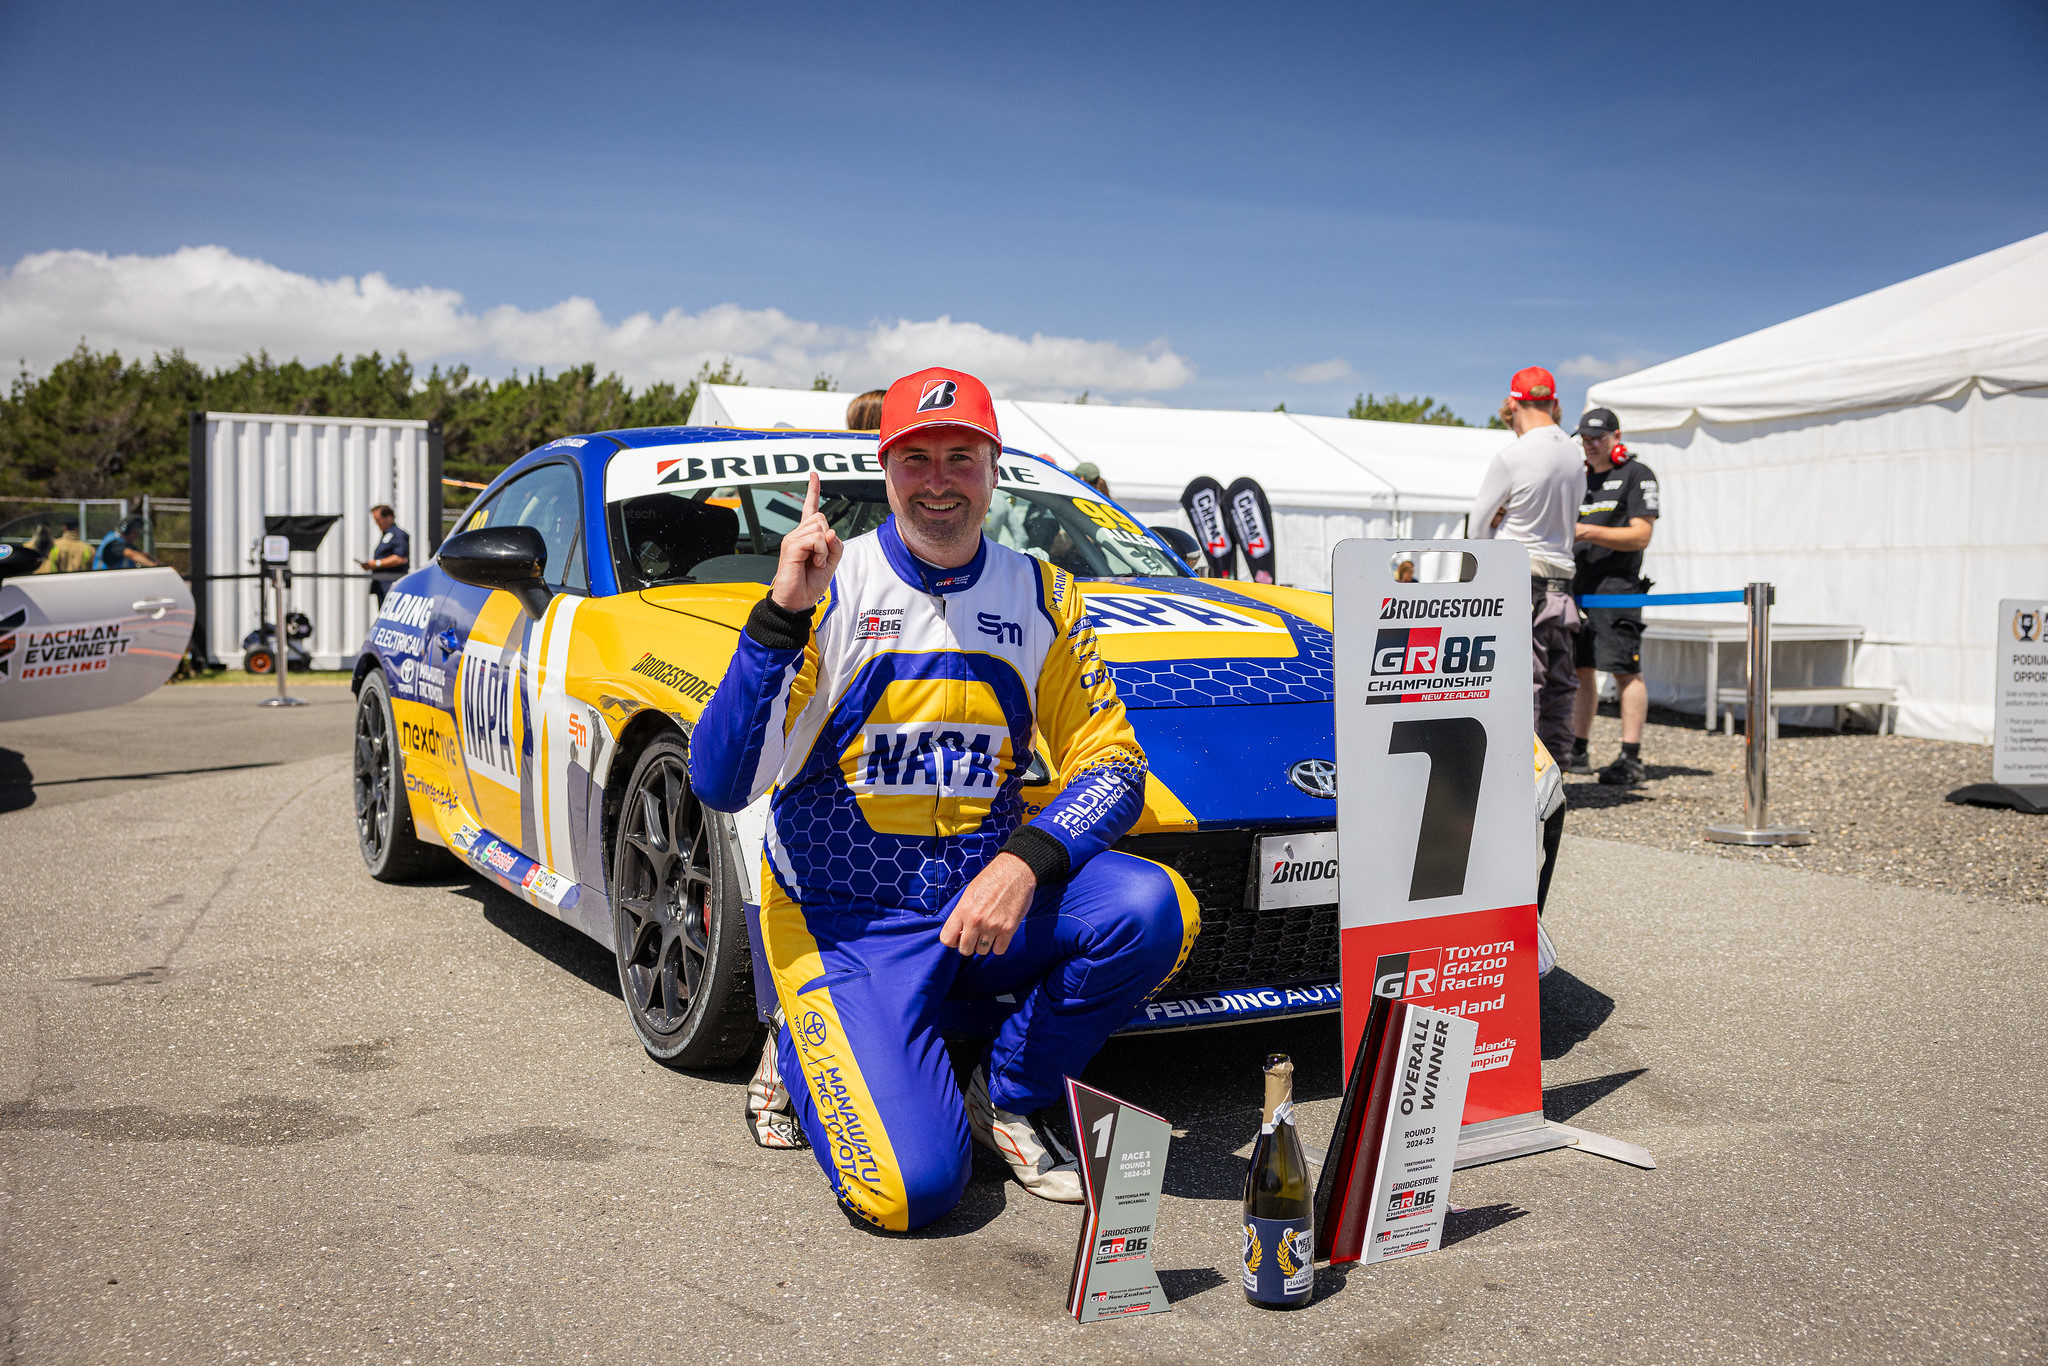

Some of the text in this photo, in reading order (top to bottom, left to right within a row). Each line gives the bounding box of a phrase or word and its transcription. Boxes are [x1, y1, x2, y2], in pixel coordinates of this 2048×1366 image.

[1072, 498, 1144, 536] 99
[1102, 527, 1164, 551] ALLEN
[379, 592, 435, 629] EILDING
[1380, 597, 1504, 620] BRIDGESTONE
[29, 624, 120, 648] LACHLAN
[25, 638, 130, 665] EVENNETT
[1442, 635, 1496, 674] 86
[22, 659, 107, 680] RACING
[631, 652, 717, 704] BRIDGESTONE
[1367, 676, 1492, 692] CHAMPIONSHIP
[1421, 691, 1487, 701] NEW ZEALAND
[463, 655, 515, 776] NAPA
[403, 717, 457, 766] nexdrive
[865, 731, 994, 787] NAPA
[489, 846, 519, 874] Castrol
[538, 870, 559, 890] TOYOTA
[1271, 859, 1337, 885] BRIDG
[1445, 940, 1515, 961] TOYOTA
[1443, 957, 1508, 976] GAZOO
[1440, 973, 1505, 991] Racing
[1145, 990, 1282, 1021] FEILDING
[1473, 1037, 1517, 1052] aland's
[1400, 1018, 1430, 1115] OVERALL
[1420, 1020, 1450, 1110] WINNER
[1471, 1054, 1509, 1068] mpion
[826, 1067, 881, 1182] MANAWATU
[1092, 1112, 1114, 1158] 1
[1404, 1126, 1436, 1139] ROUND 3
[1406, 1137, 1434, 1149] 2024-25
[1120, 1161, 1146, 1171] ROUND
[1121, 1151, 1151, 1161] RACE 3
[1123, 1169, 1151, 1178] 2024-25
[1392, 1175, 1440, 1191] BRIDGESTONE
[1101, 1225, 1151, 1237] BRIDGESTONE
[1406, 1227, 1431, 1237] Zealand
[1123, 1290, 1151, 1298] Zealand
